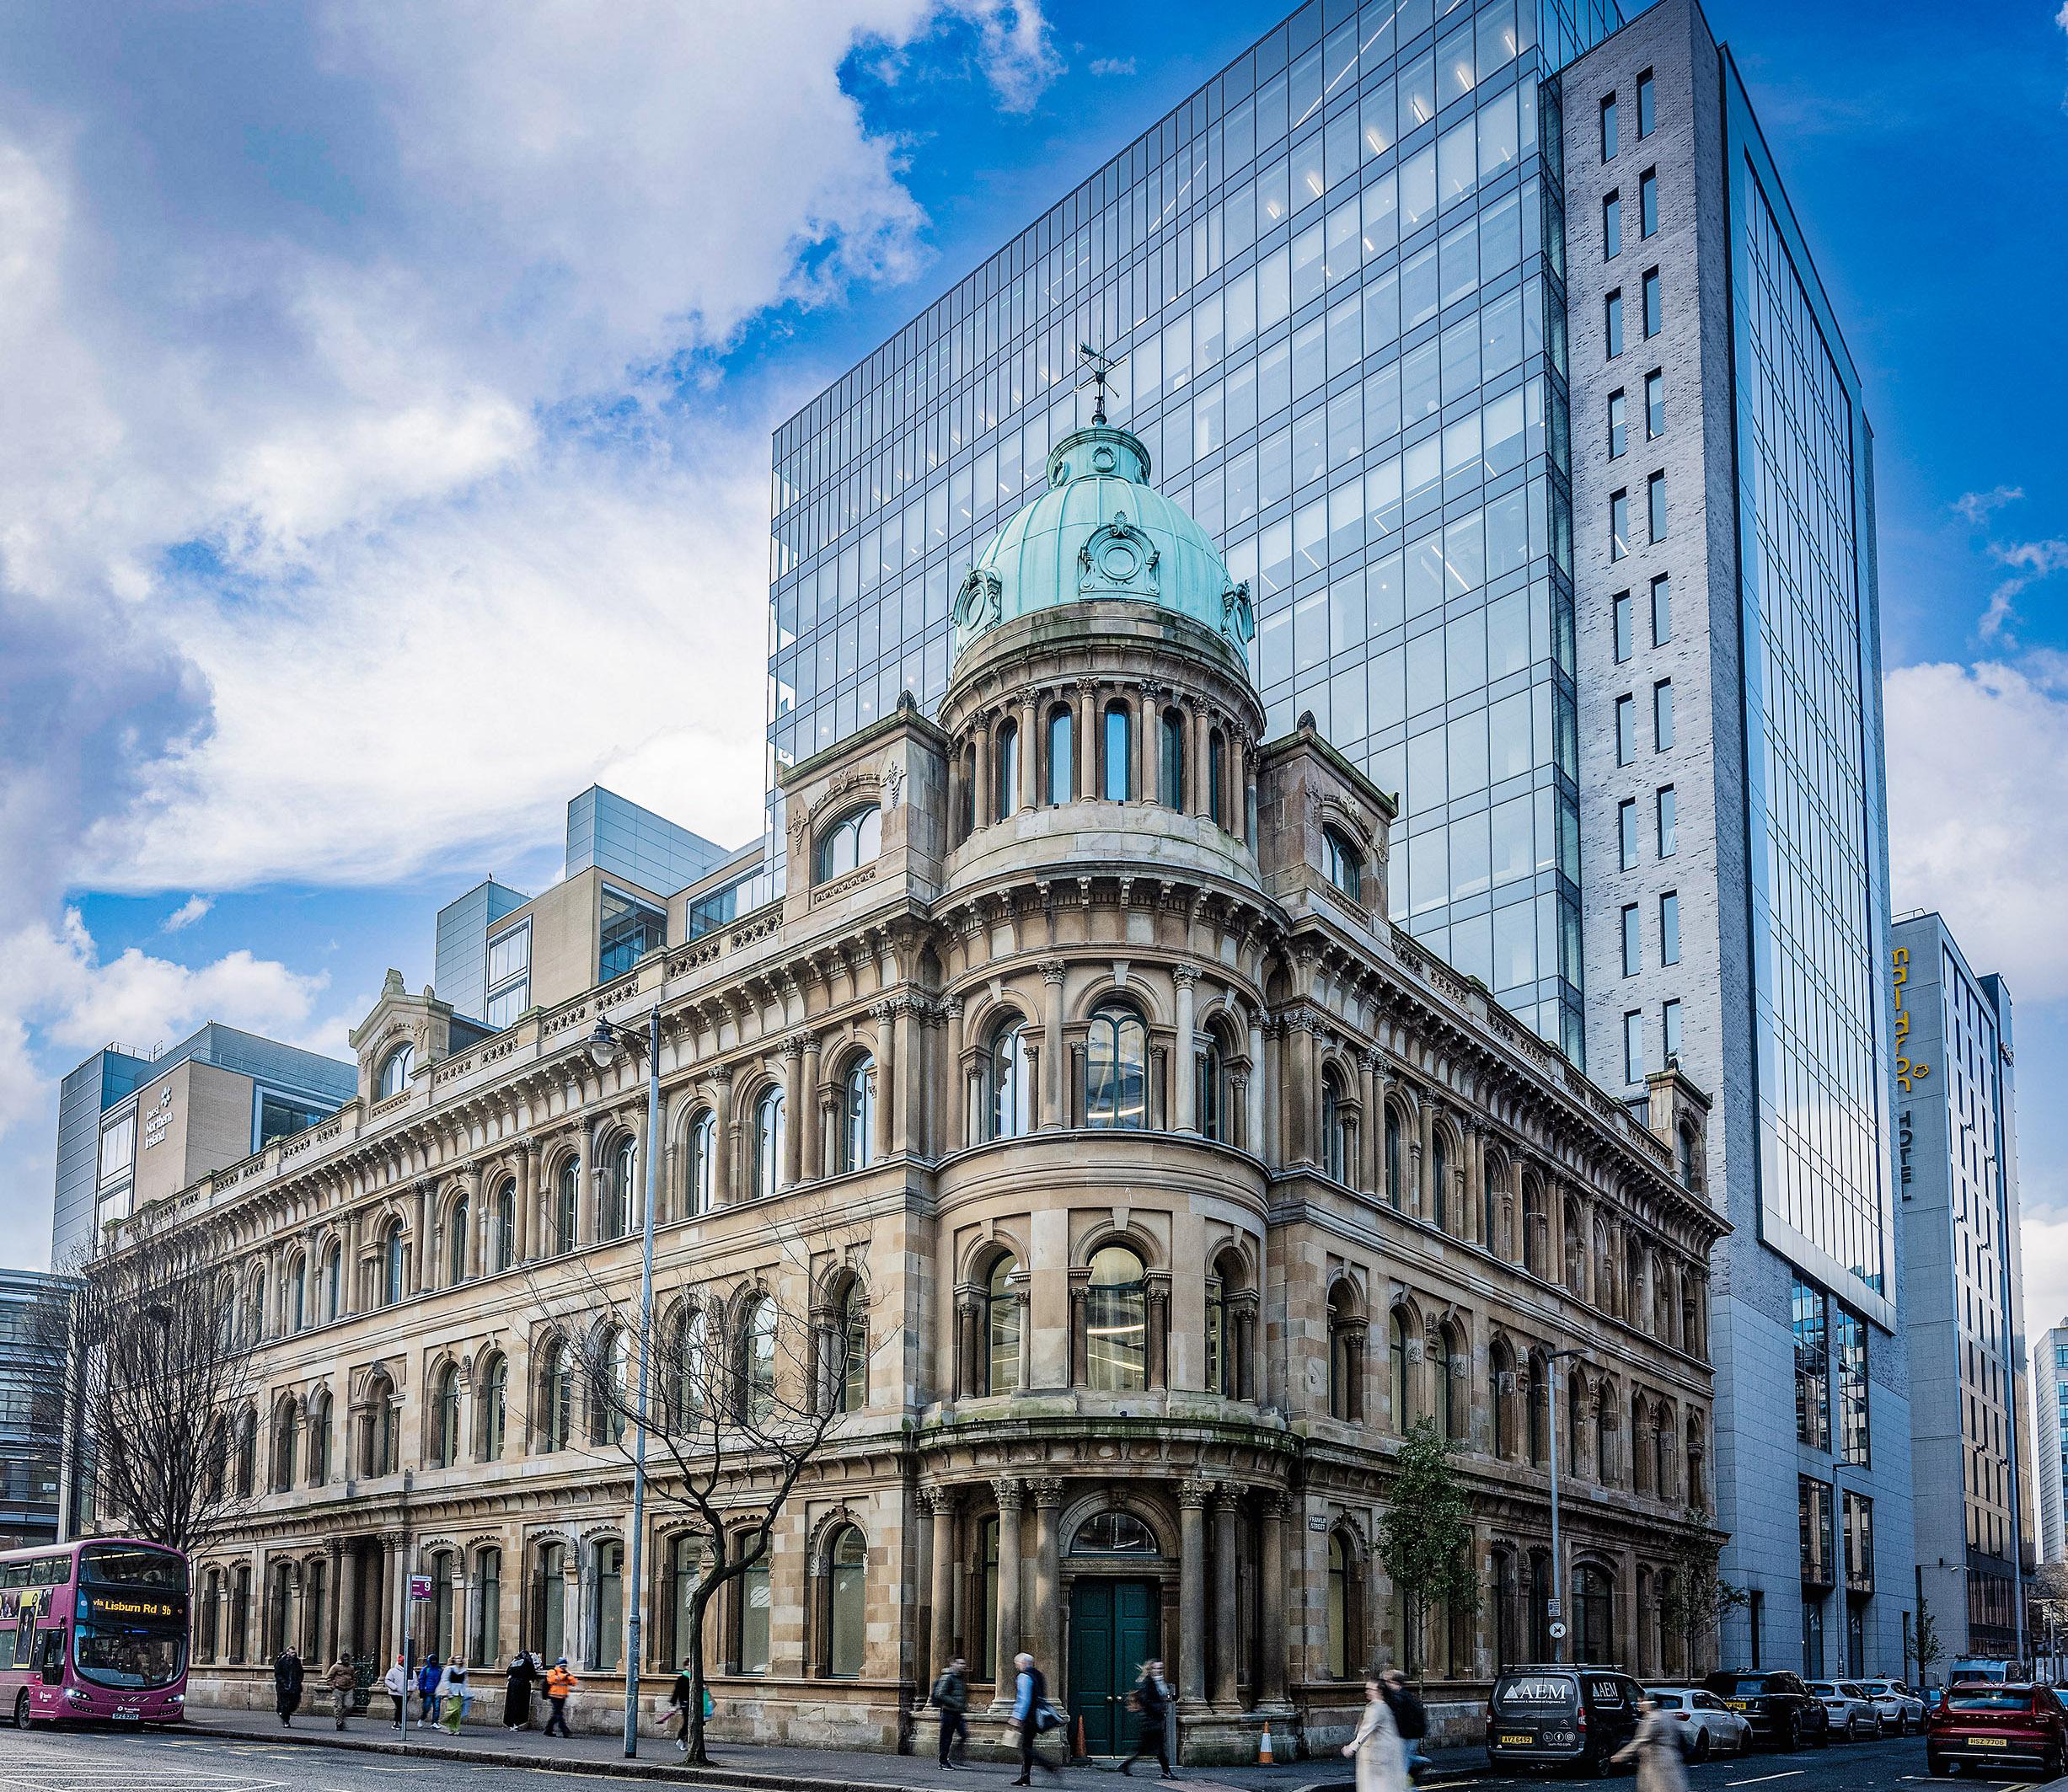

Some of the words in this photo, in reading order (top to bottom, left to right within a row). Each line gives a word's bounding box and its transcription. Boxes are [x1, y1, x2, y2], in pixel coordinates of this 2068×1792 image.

[146, 1112, 173, 1135] Northern
[145, 1126, 165, 1150] Ireland
[1899, 1110, 1913, 1201] HOTEL
[424, 1581, 431, 1591] 9
[104, 1601, 141, 1613] Lisburn
[143, 1603, 158, 1613] Rd
[162, 1605, 171, 1615] 9b
[1519, 1684, 1567, 1699] AEM
[1599, 1682, 1618, 1698] AEM
